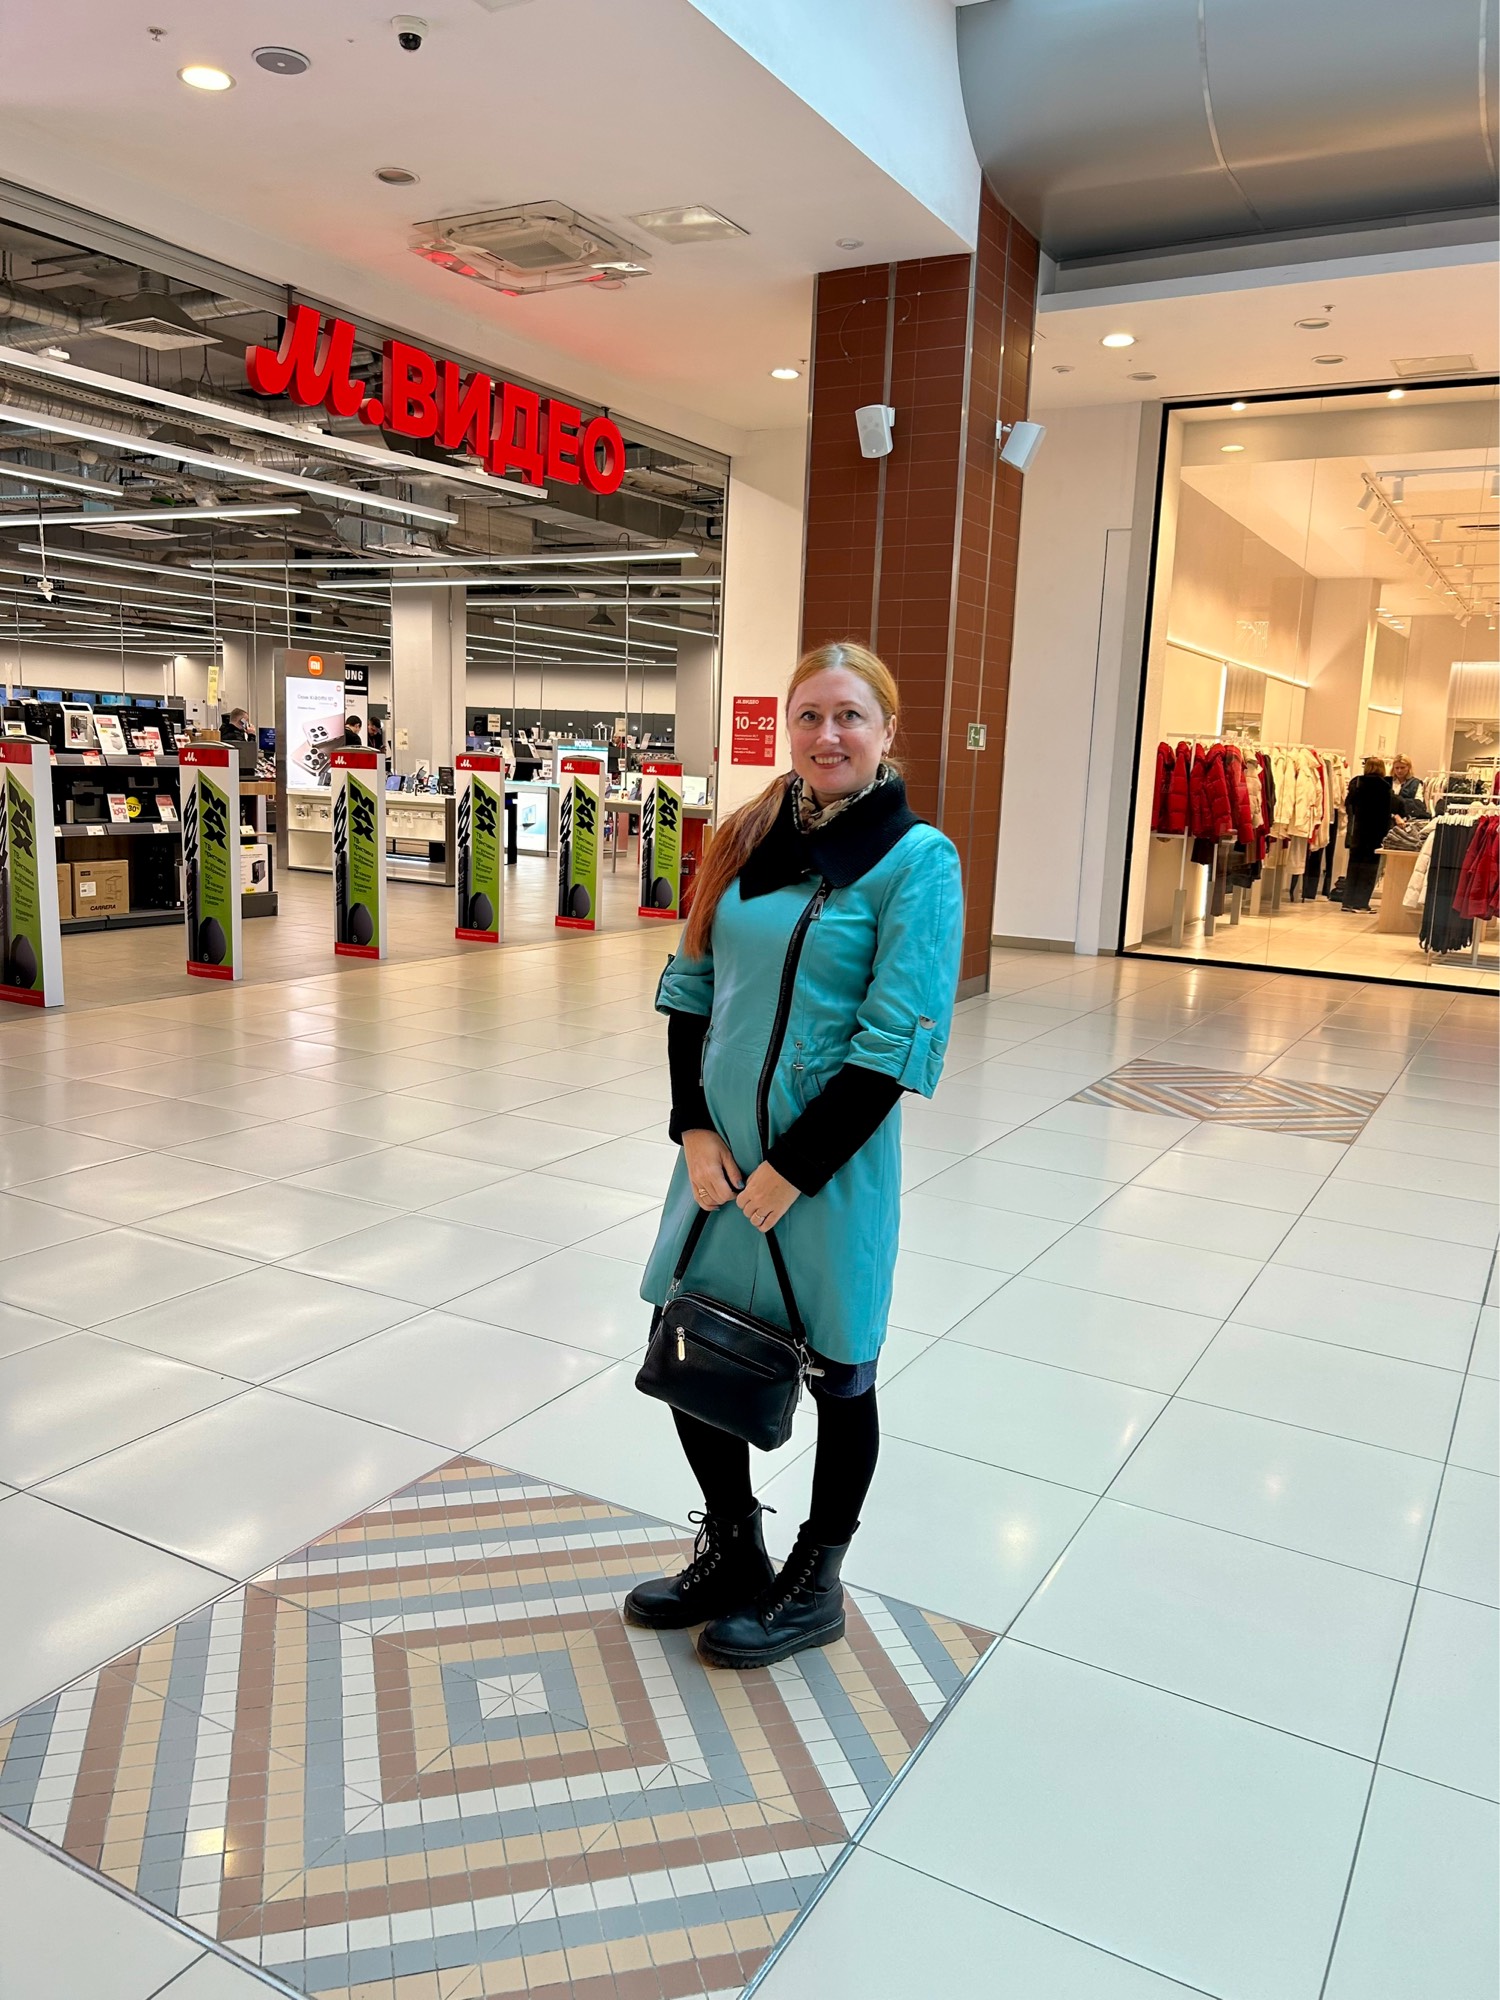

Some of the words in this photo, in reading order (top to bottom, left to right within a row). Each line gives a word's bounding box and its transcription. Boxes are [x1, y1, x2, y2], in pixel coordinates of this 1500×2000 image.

[245, 303, 626, 495] М.ВИДЕО
[9, 781, 34, 859] MAX
[201, 781, 228, 850] MAX
[350, 782, 375, 843] MAX
[474, 783, 497, 839] MAX
[575, 784, 596, 835] MAX
[658, 786, 678, 832] MAX
